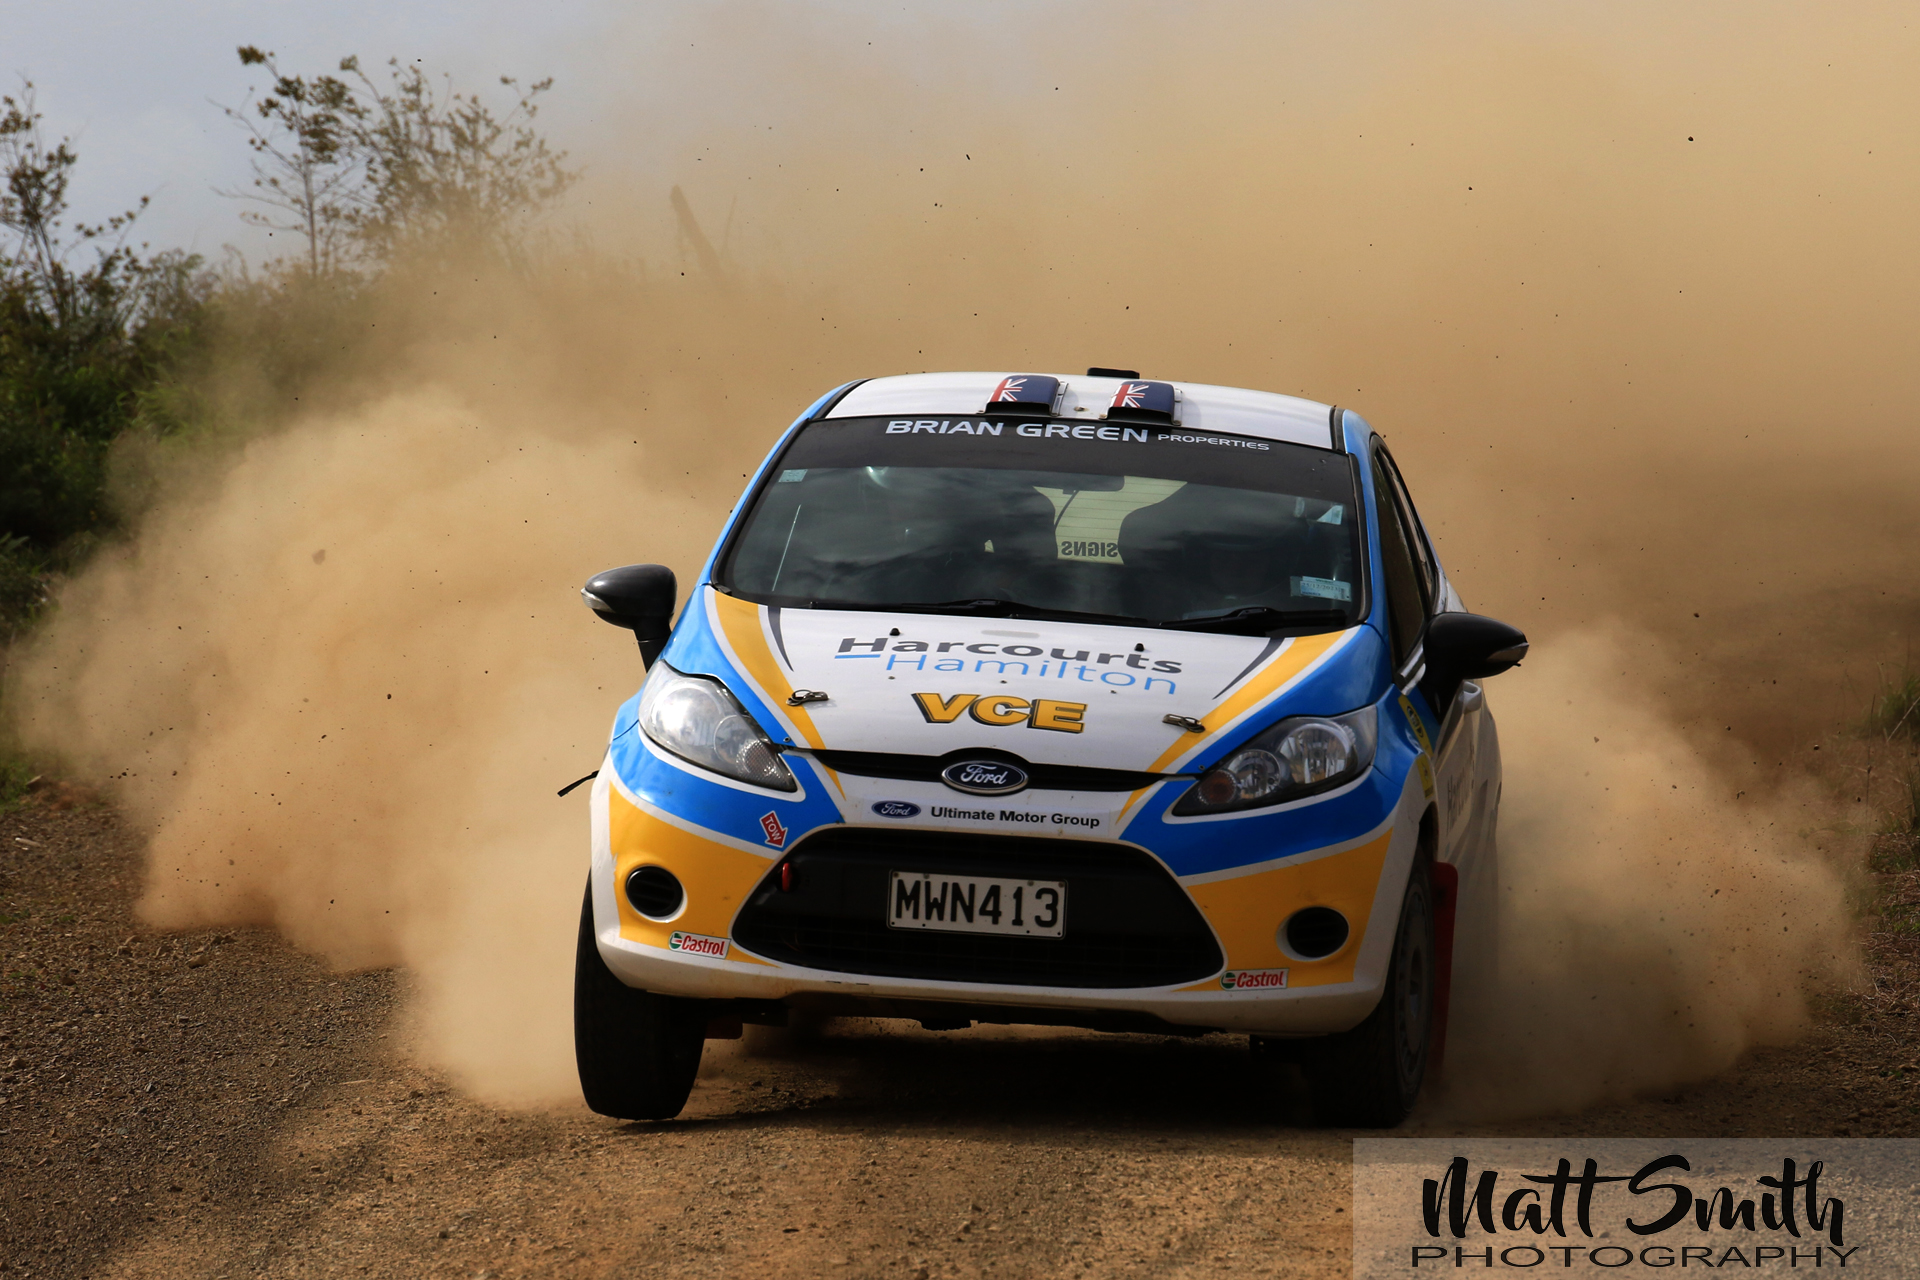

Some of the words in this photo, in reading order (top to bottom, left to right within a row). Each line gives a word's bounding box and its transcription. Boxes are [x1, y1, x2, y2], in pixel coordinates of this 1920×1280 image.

[884, 420, 1004, 436] BRIAN
[1016, 423, 1149, 442] GREEN
[1157, 433, 1270, 451] PROPERTIES
[837, 637, 1183, 674] Harcourts
[886, 654, 1177, 695] Hamilton
[911, 692, 1088, 733] VCE
[960, 764, 1007, 784] Ford
[765, 816, 782, 841] TOW
[881, 802, 911, 816] Ford
[931, 806, 995, 821] Ultimate
[1000, 810, 1047, 823] Motor
[1051, 813, 1100, 829] Group
[895, 879, 1059, 928] MWN413
[682, 935, 725, 956] Castrol
[1236, 971, 1285, 988] Castrol
